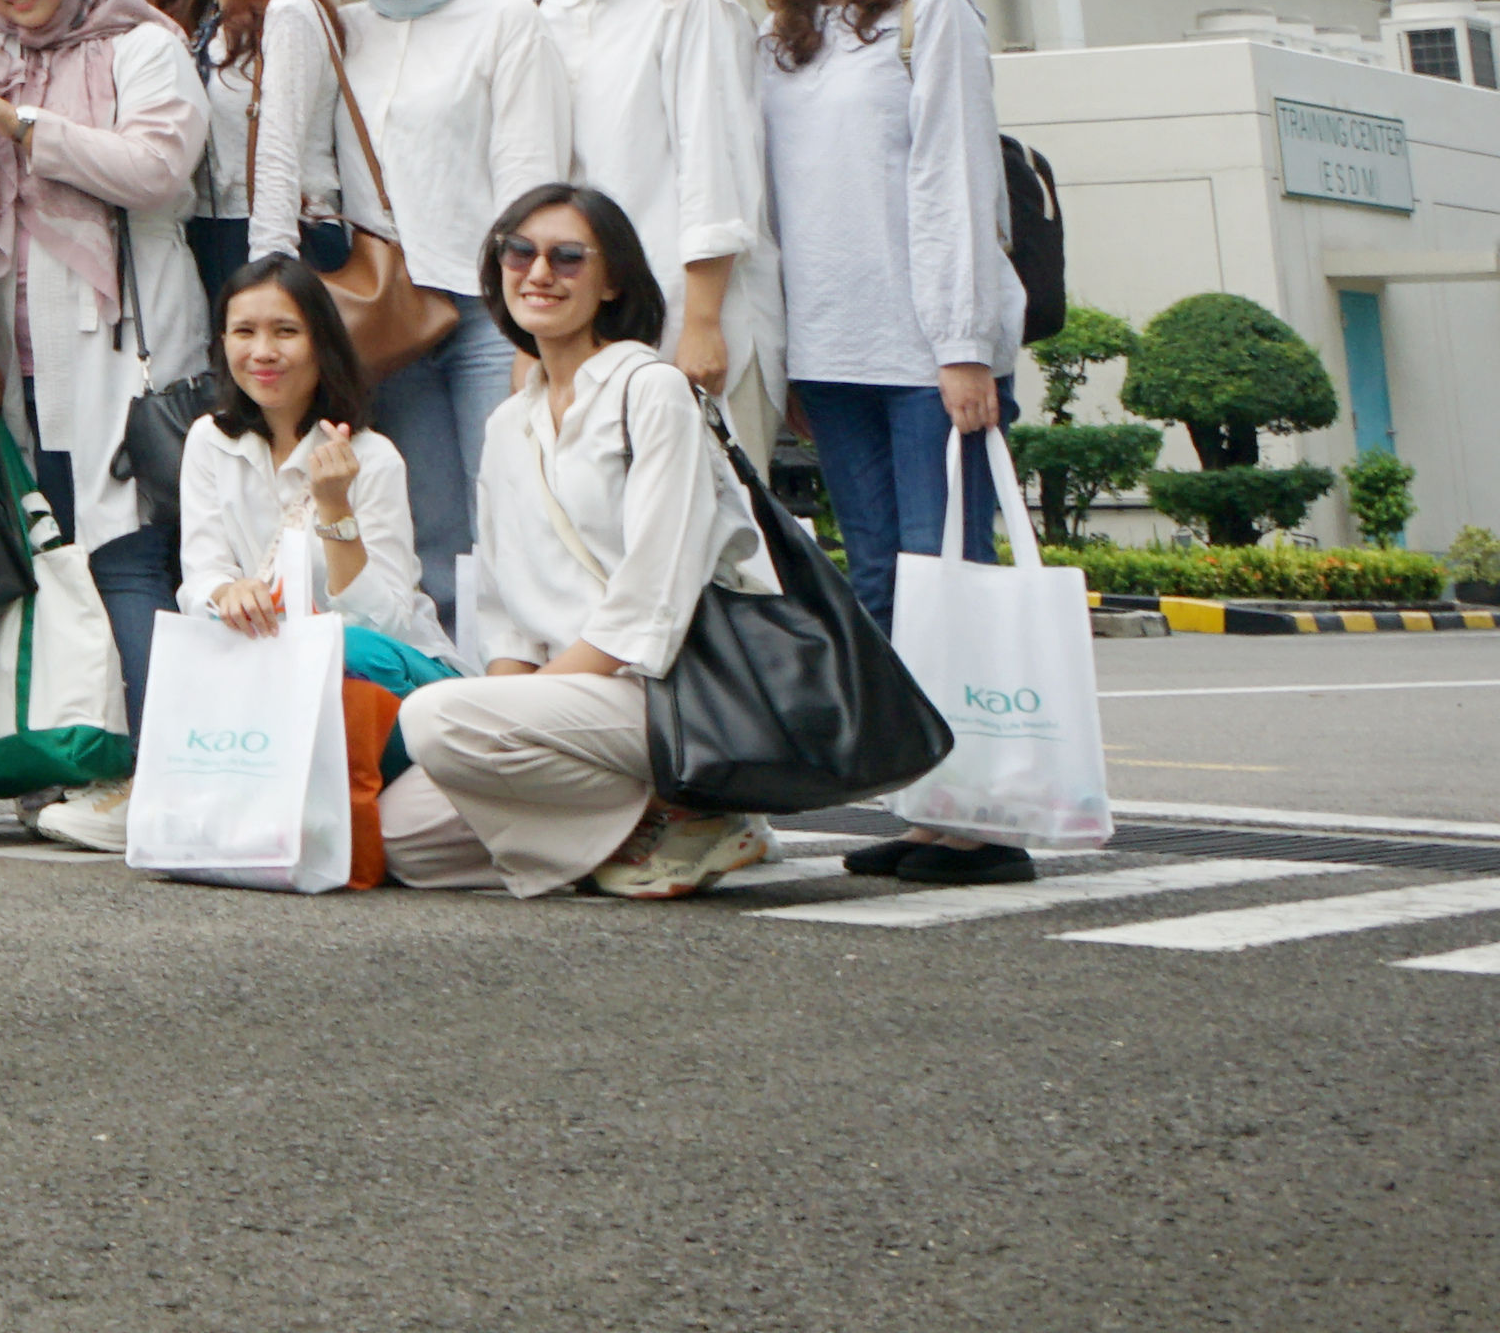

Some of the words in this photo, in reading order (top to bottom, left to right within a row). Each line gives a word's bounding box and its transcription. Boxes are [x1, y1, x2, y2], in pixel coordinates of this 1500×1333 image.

[1280, 107, 1349, 148] TRAINING
[1350, 119, 1408, 158] CENTER
[964, 684, 1041, 715] kao
[186, 729, 269, 754] kao
